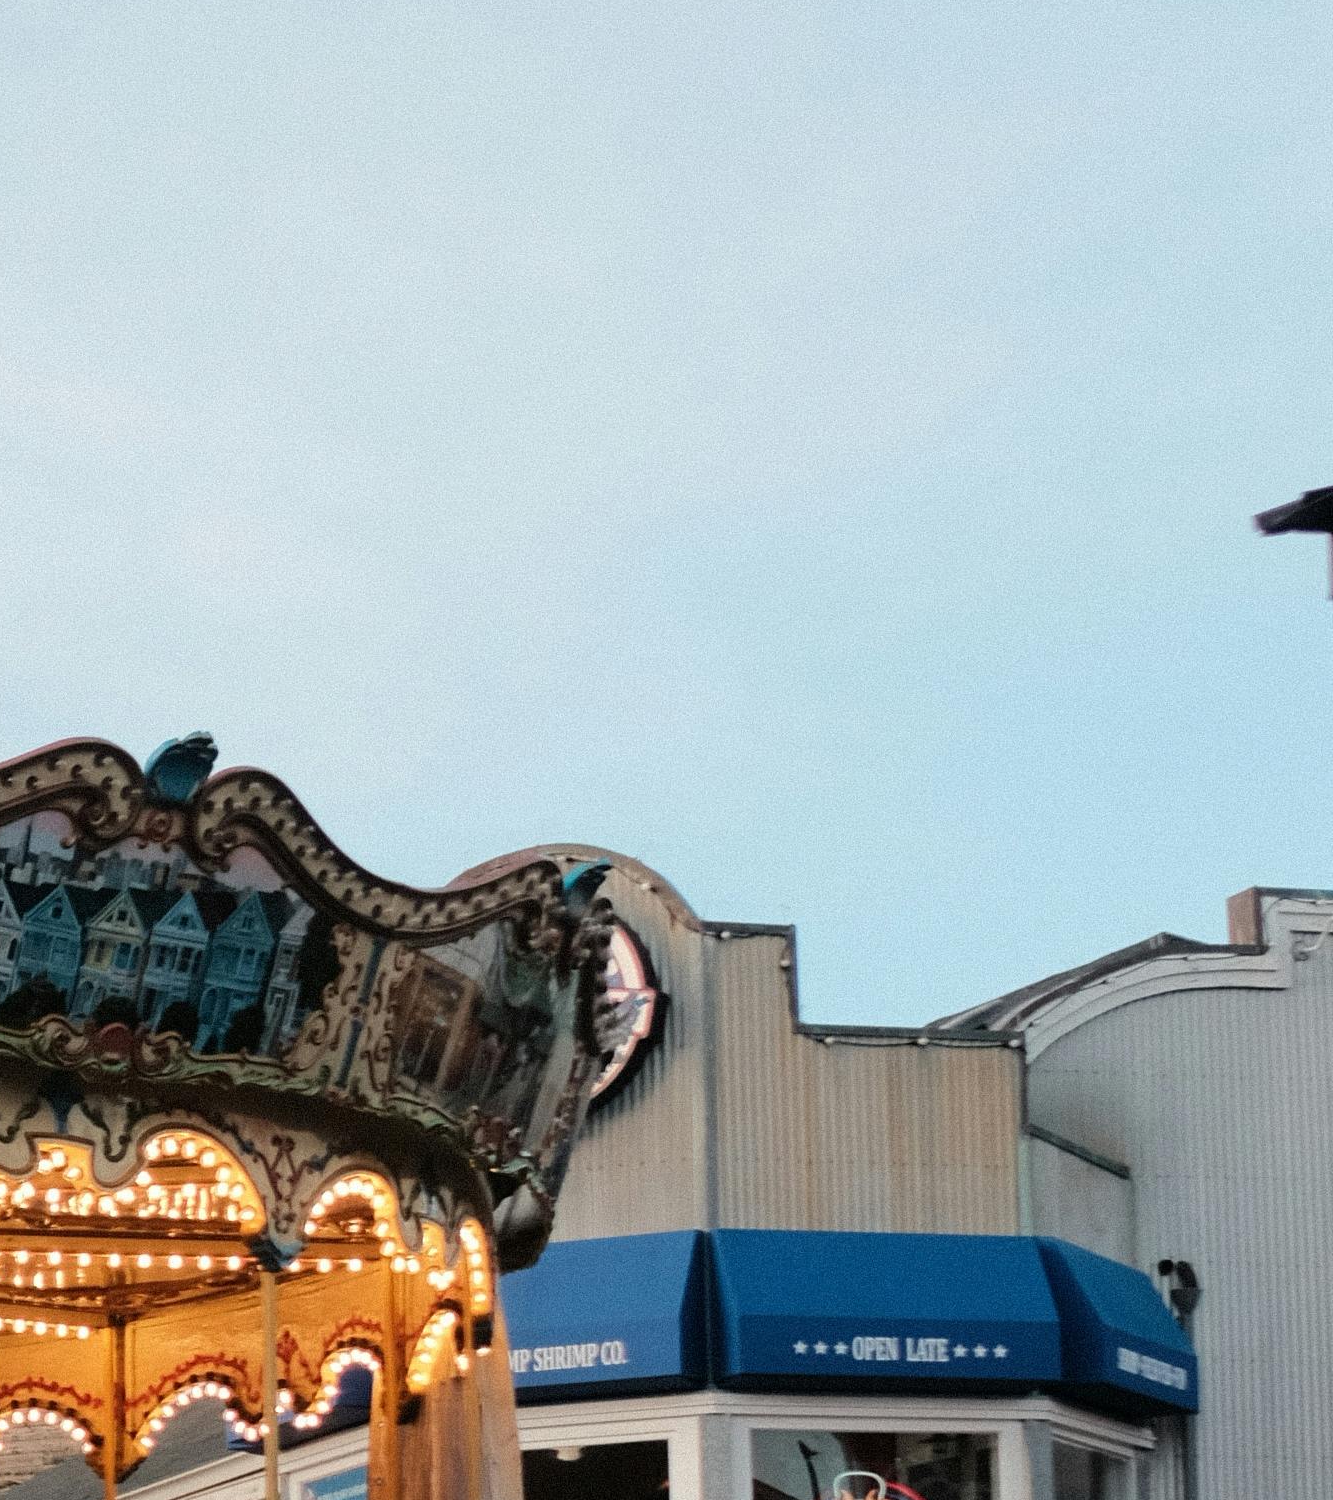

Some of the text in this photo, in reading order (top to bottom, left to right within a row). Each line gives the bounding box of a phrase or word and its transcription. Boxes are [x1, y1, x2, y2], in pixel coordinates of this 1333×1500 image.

[508, 1340, 627, 1372] MP SHRIMP CO.
[852, 1336, 950, 1362] OPEN LATE
